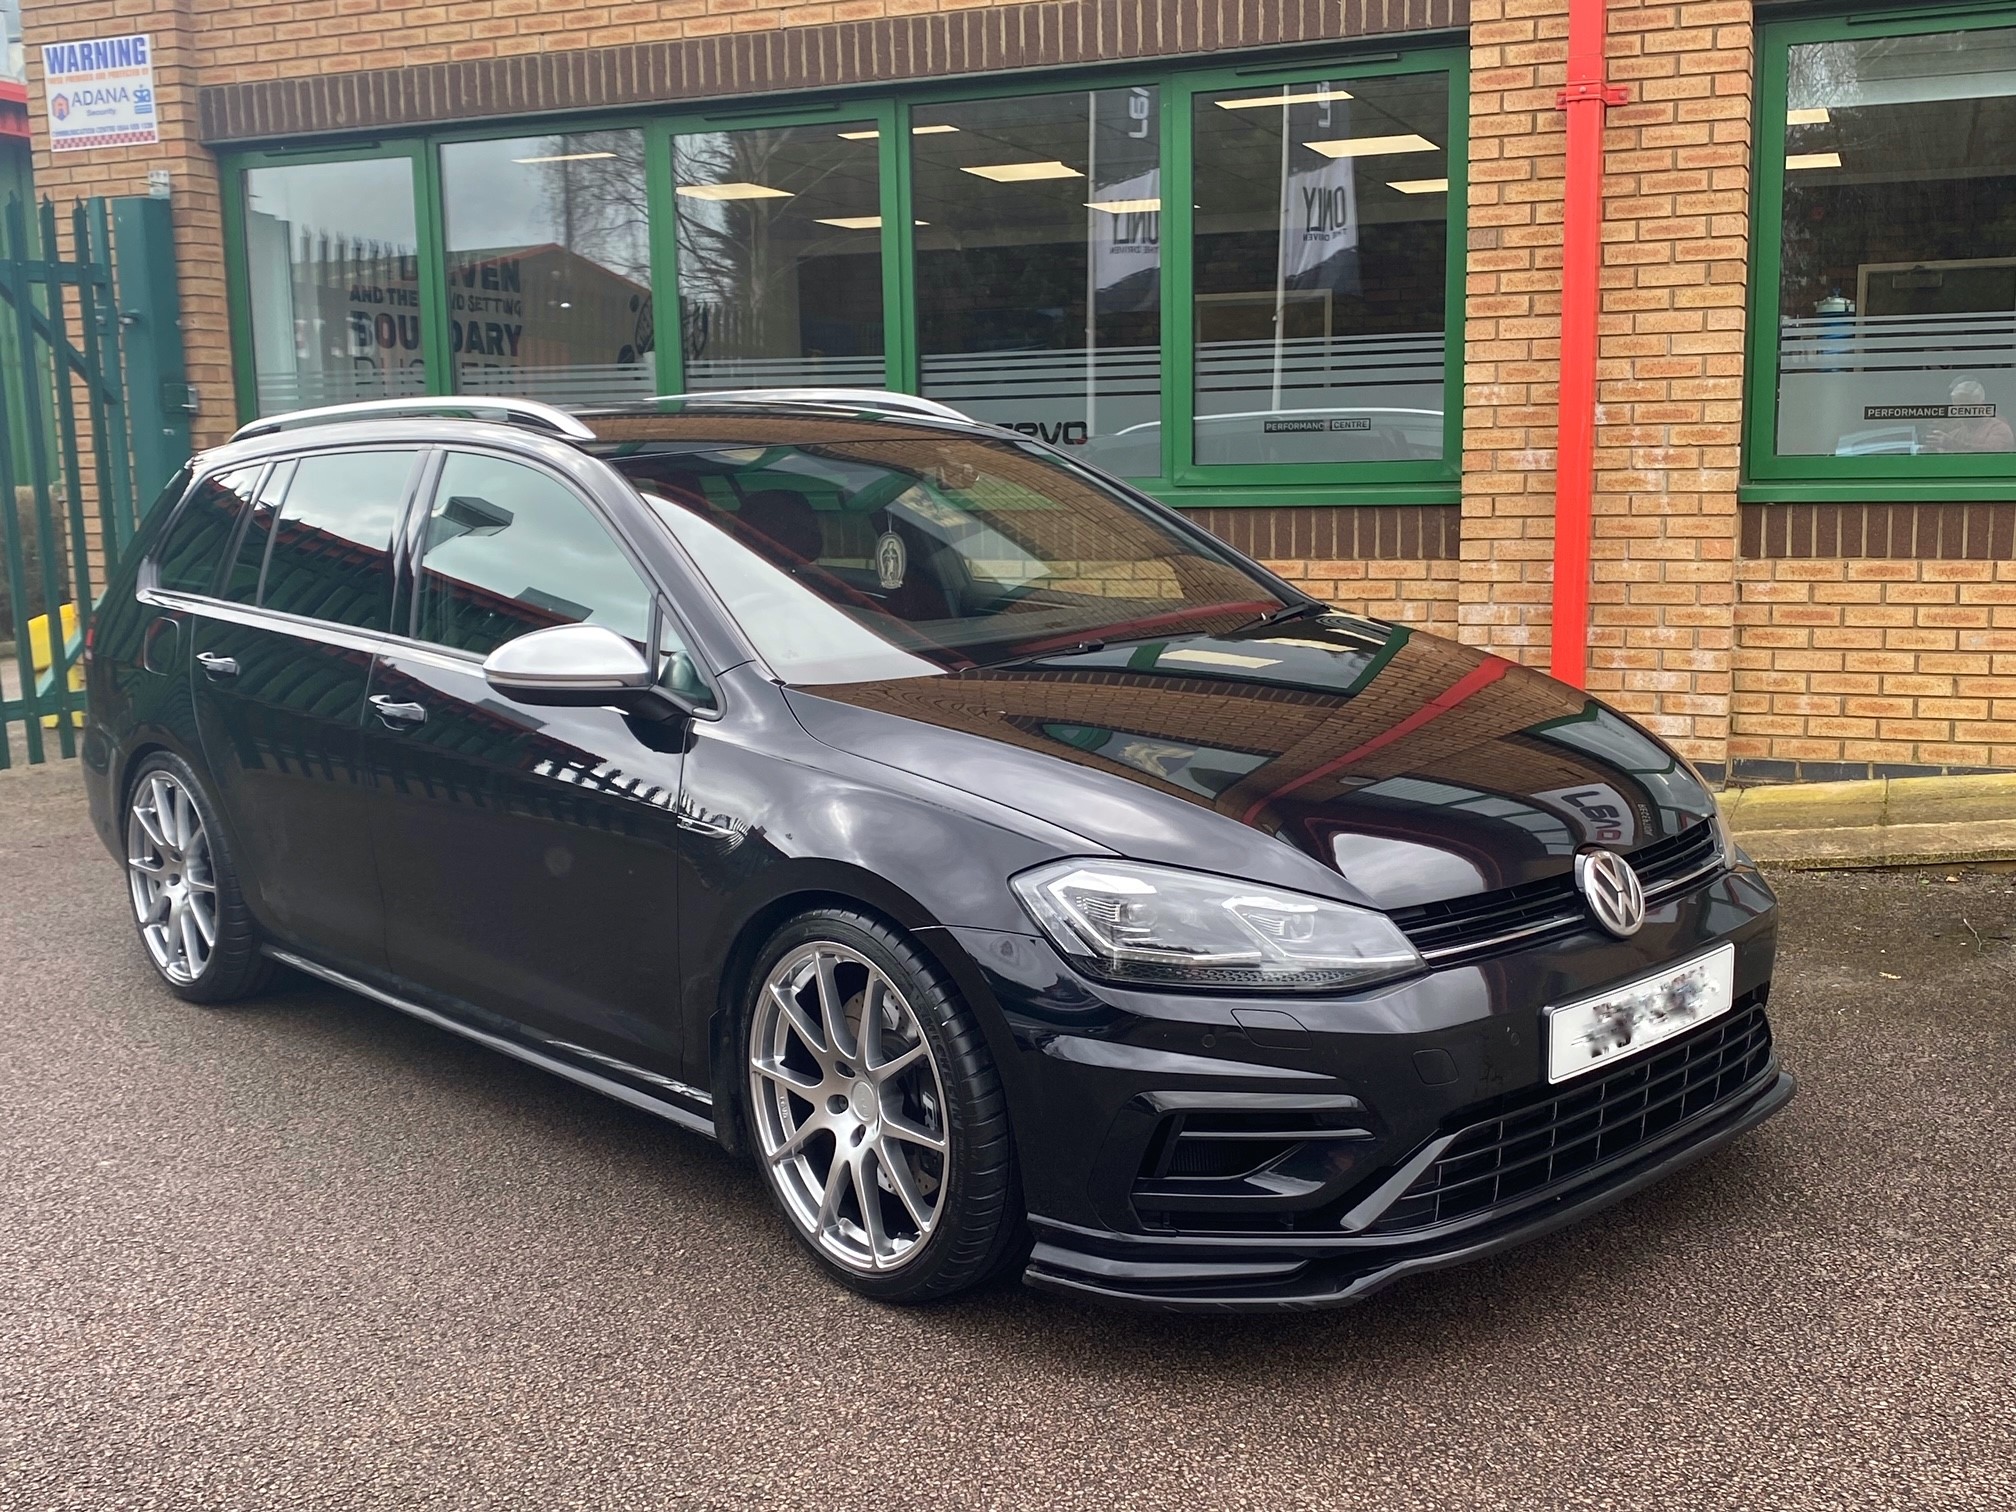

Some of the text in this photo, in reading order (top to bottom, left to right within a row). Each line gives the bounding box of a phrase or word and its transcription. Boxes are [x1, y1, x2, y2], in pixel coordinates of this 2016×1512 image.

[44, 37, 147, 75] WARNING
[71, 86, 131, 107] ADANA
[86, 108, 117, 117] Security
[350, 285, 384, 304] AND
[386, 288, 419, 308] THE
[467, 294, 522, 317] SETTING
[350, 310, 522, 358] BOUDARY
[1865, 405, 1993, 418] PERFORMANCE CENTRE
[1333, 419, 1368, 430] CENTRE
